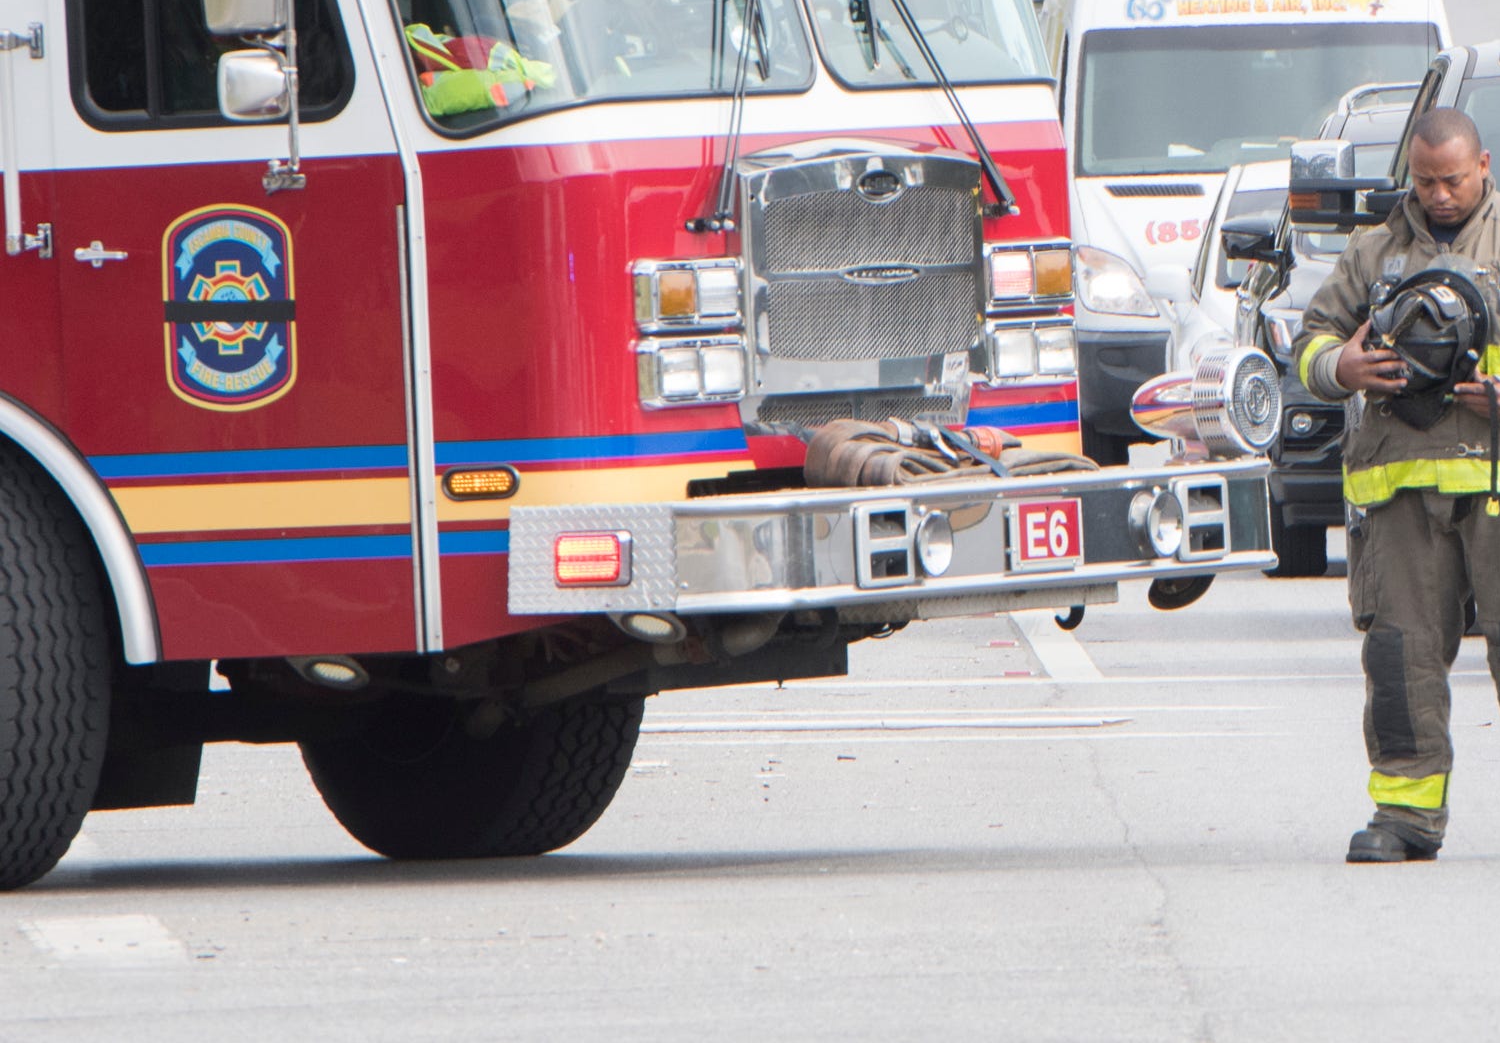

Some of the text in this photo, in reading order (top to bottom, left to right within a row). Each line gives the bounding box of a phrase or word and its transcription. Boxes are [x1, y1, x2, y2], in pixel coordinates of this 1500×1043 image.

[1145, 218, 1208, 246] (85
[190, 359, 273, 391] FIRE-RESCUE
[1026, 509, 1069, 558] E6
